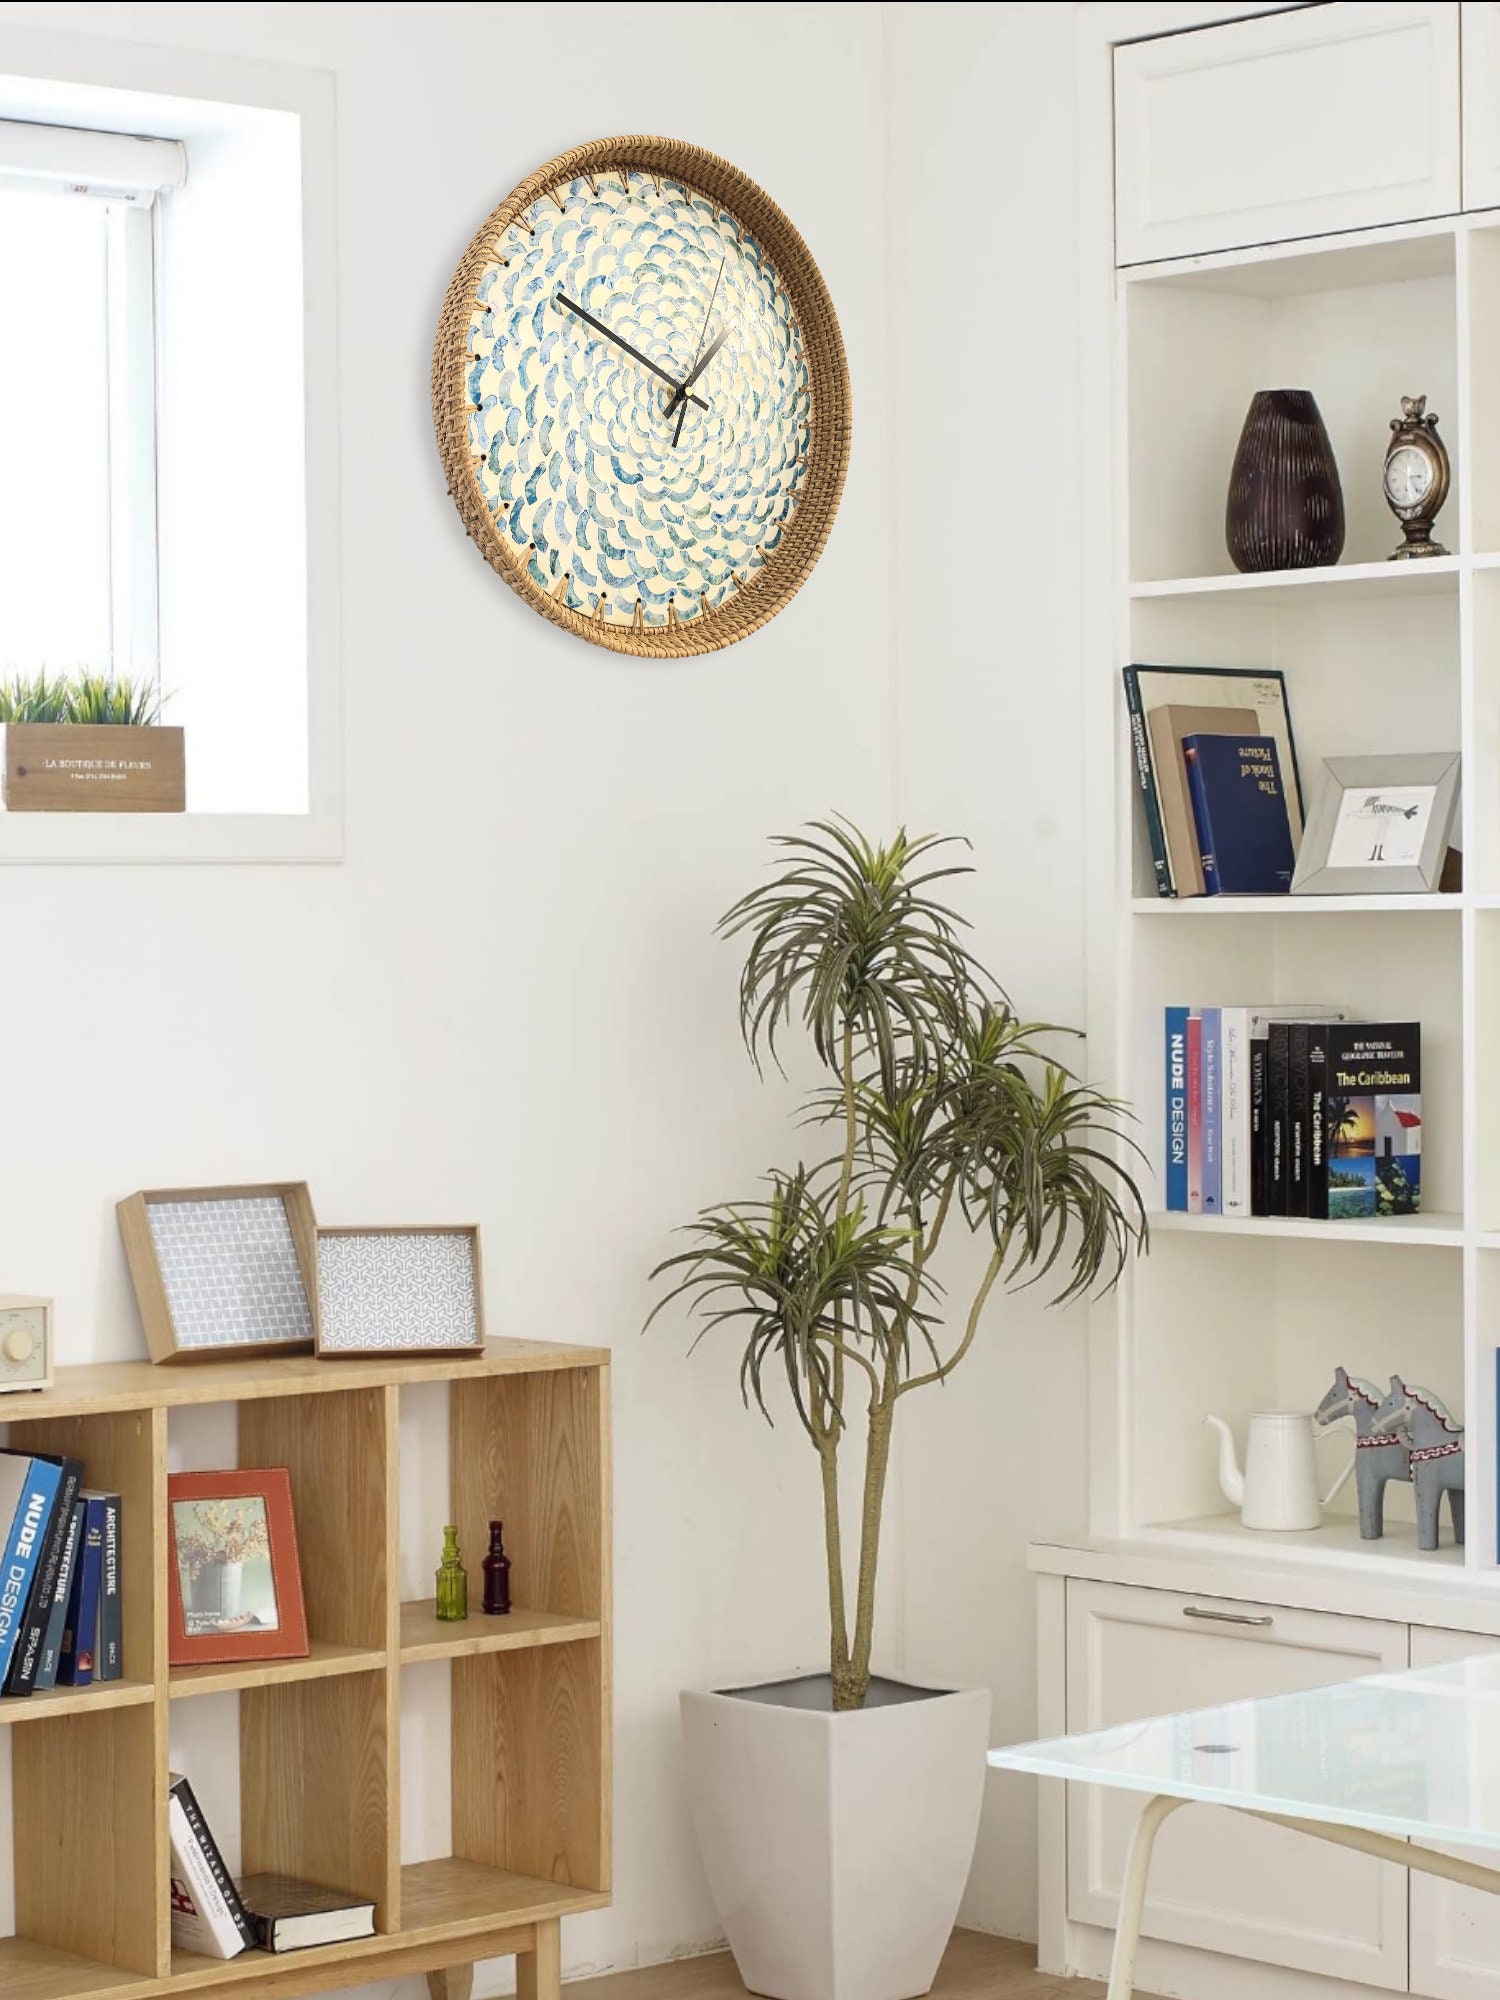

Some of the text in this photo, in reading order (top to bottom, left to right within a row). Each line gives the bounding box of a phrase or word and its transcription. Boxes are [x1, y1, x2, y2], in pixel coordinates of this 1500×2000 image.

[1238, 748, 1273, 761] Picture
[1251, 764, 1275, 778] Book
[1258, 781, 1278, 794] The
[1171, 1033, 1184, 1165] NUDE DESIGN
[1336, 1070, 1411, 1087] The Caribbean
[1313, 1091, 1323, 1167] The Caribbean
[15, 1492, 46, 1560] NUDE
[106, 1506, 117, 1596] ARCHITECTURE
[186, 1805, 201, 1830] THE
[199, 1834, 225, 1885] WIZARD
